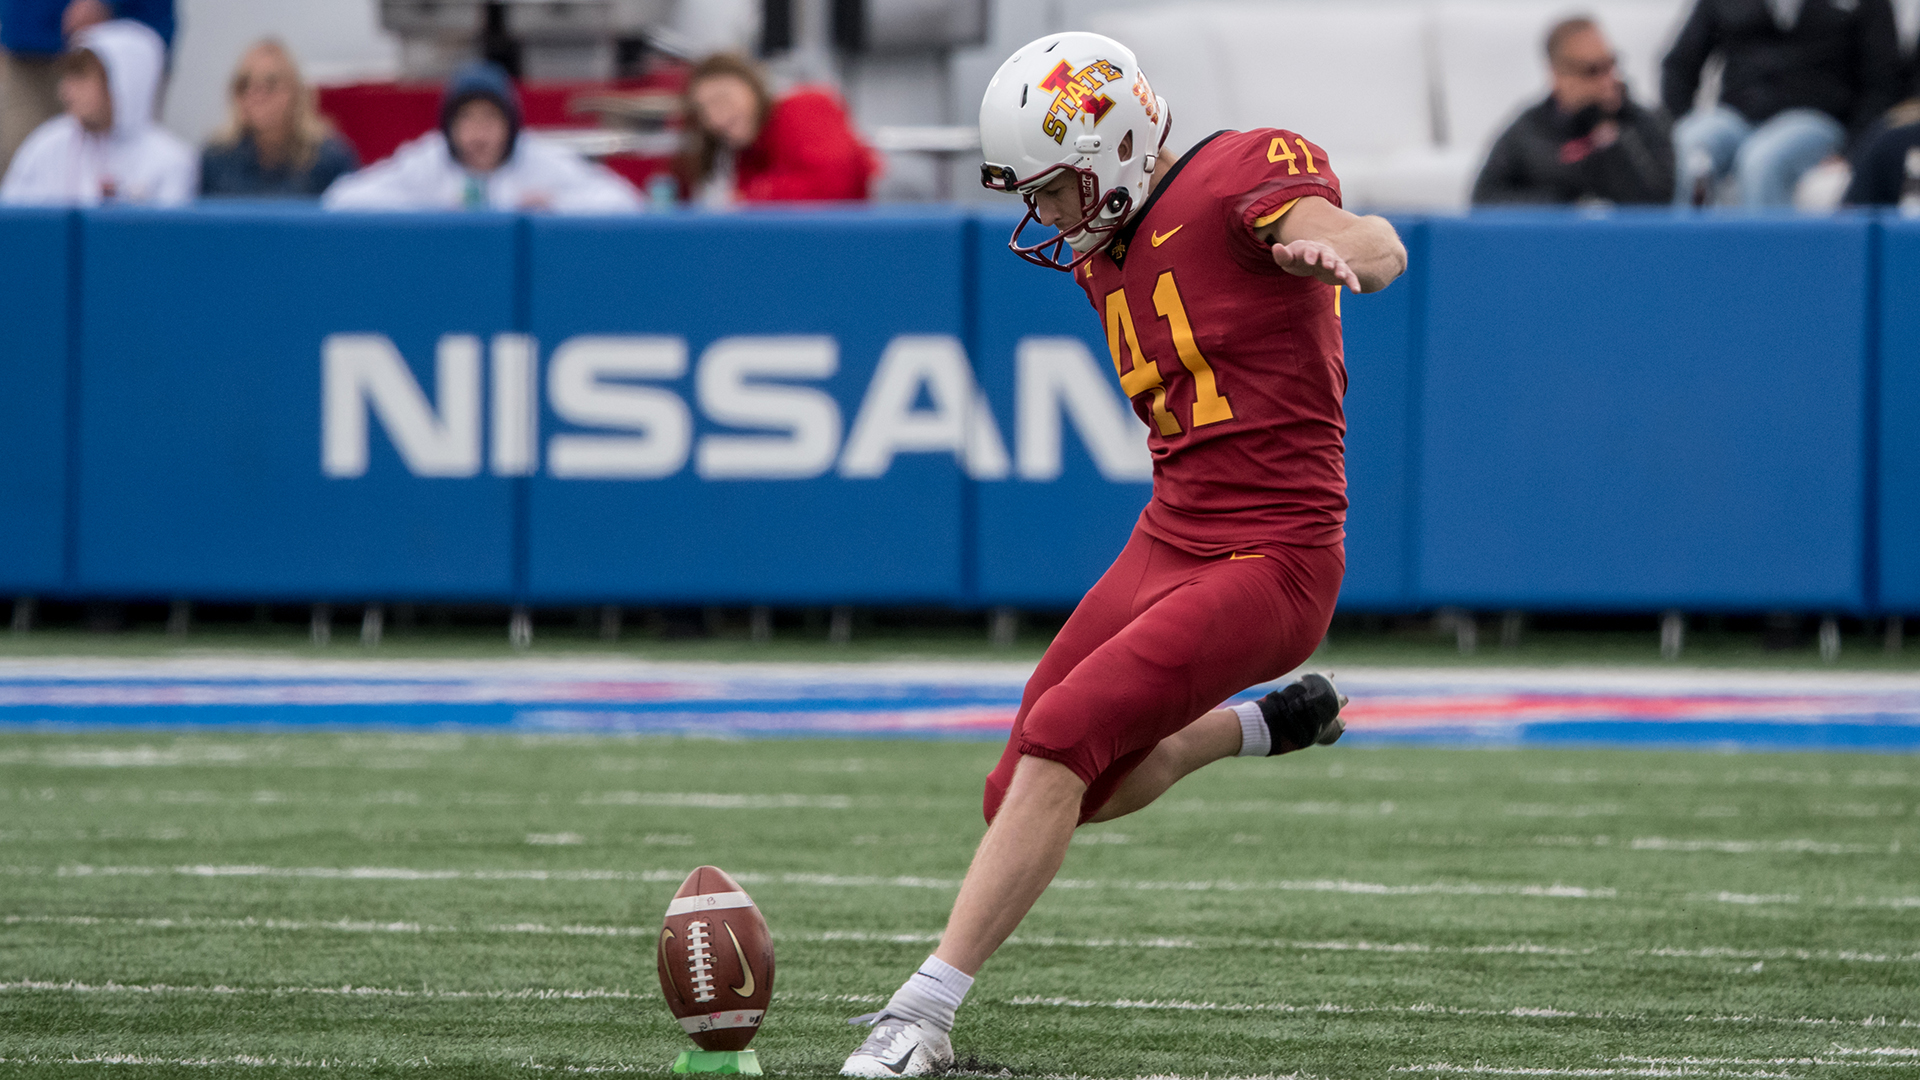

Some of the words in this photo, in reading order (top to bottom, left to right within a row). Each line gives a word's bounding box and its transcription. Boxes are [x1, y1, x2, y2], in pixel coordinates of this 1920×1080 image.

[1043, 59, 1123, 145] STATE
[1267, 137, 1319, 175] 41
[321, 334, 1153, 479] NISSAN
[1105, 271, 1234, 436] 41
